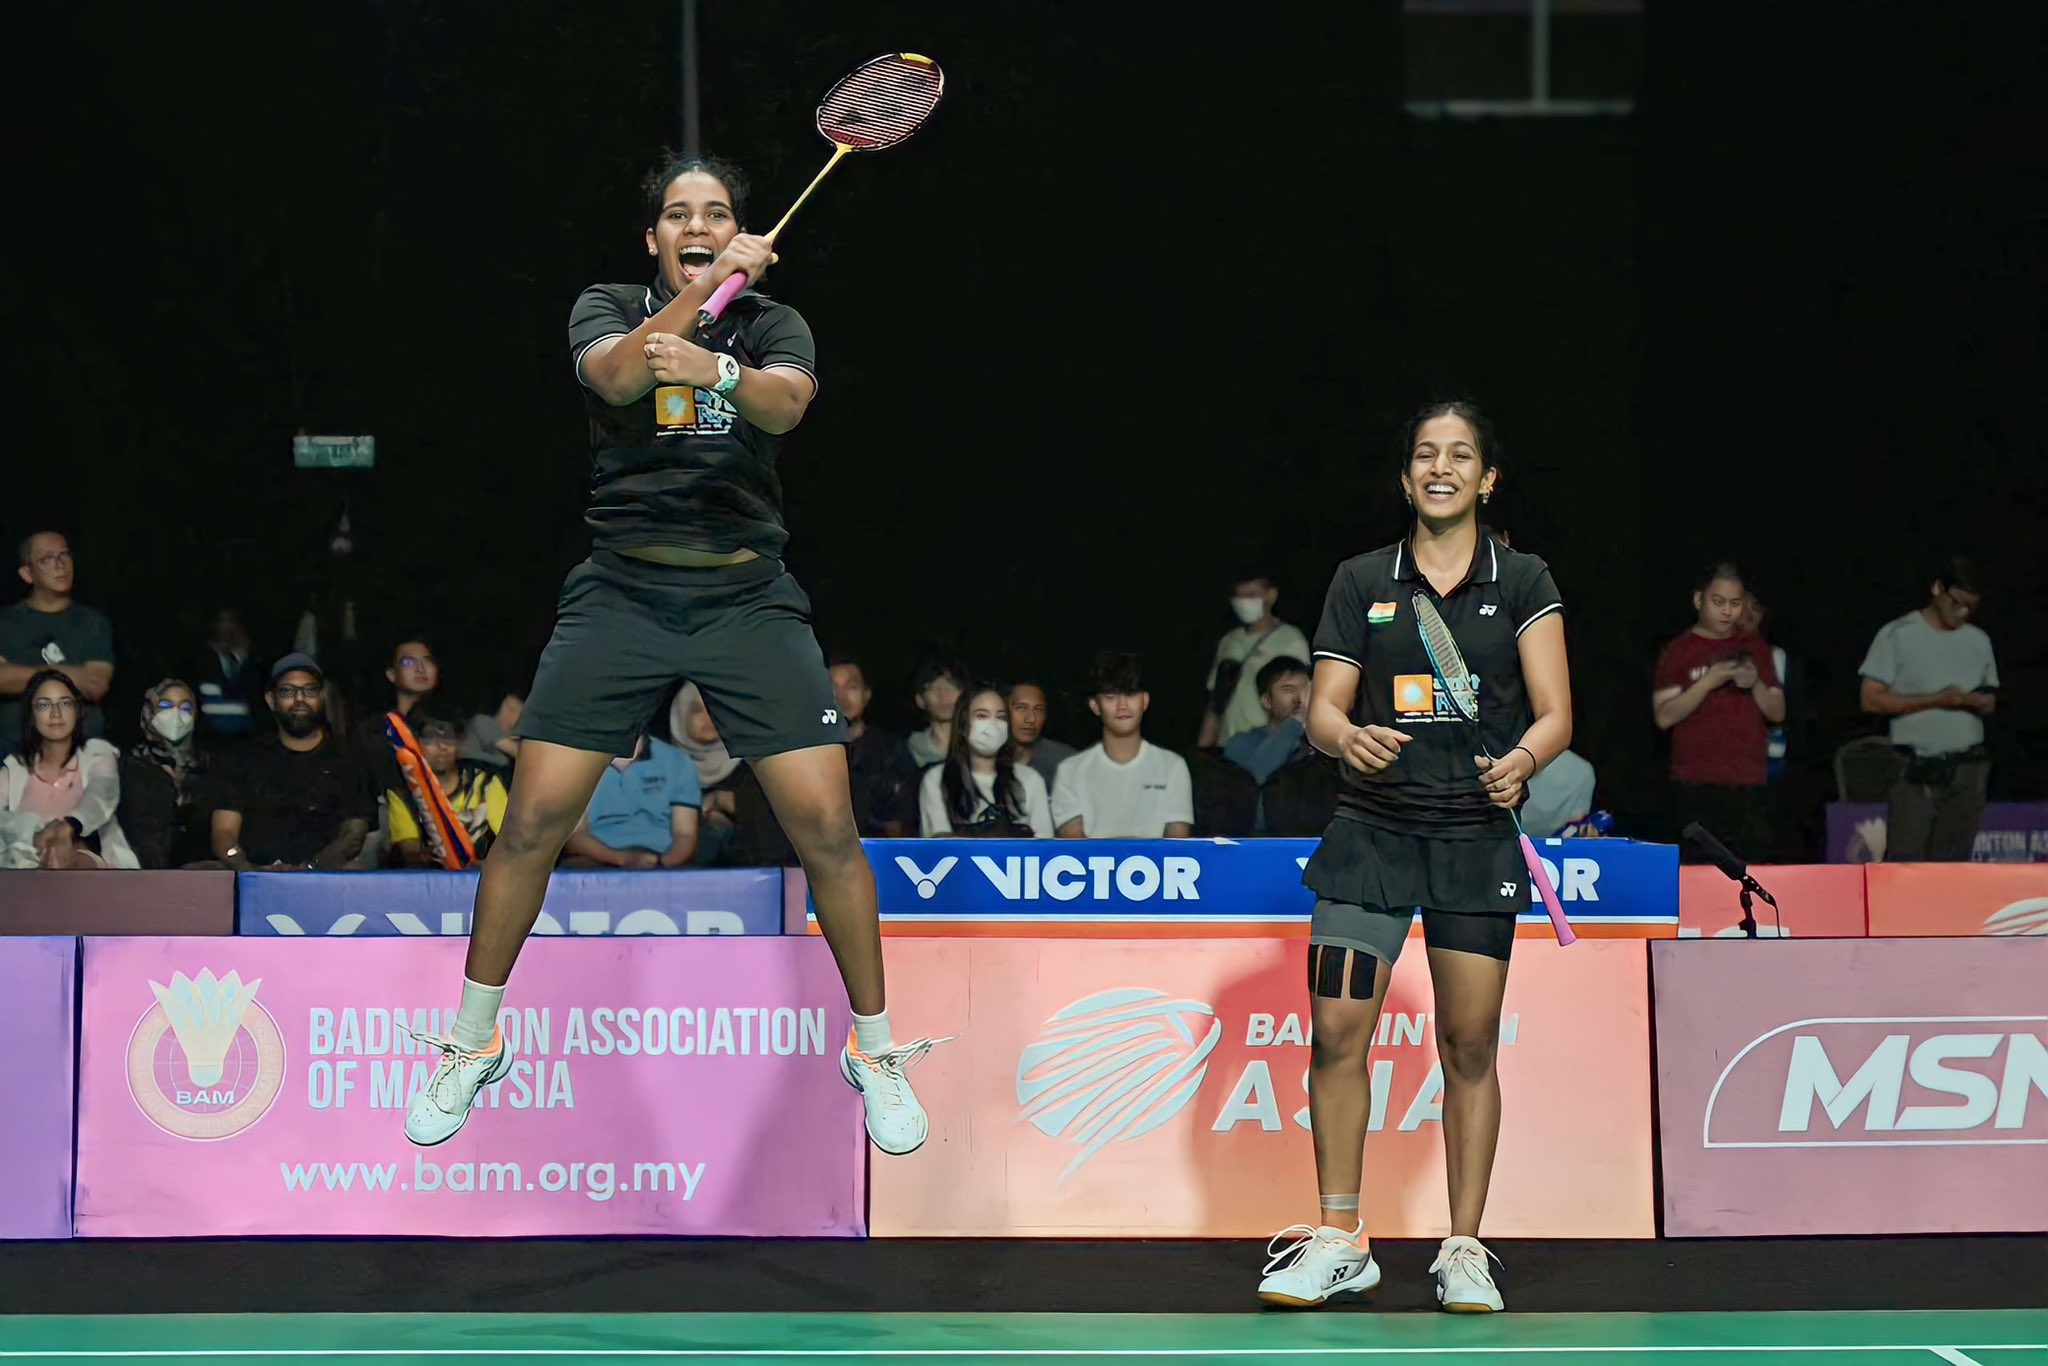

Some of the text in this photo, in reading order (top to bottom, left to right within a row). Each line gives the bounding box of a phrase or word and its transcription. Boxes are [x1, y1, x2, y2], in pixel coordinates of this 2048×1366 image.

[970, 855, 1201, 901] VICTOR
[309, 1007, 825, 1056] BADMION ASSOCIATION
[176, 1090, 235, 1105] BAM
[308, 1061, 575, 1109] OF MASIA
[1210, 1060, 1443, 1132] AIA
[280, 1152, 706, 1200] www.bam.org.my
